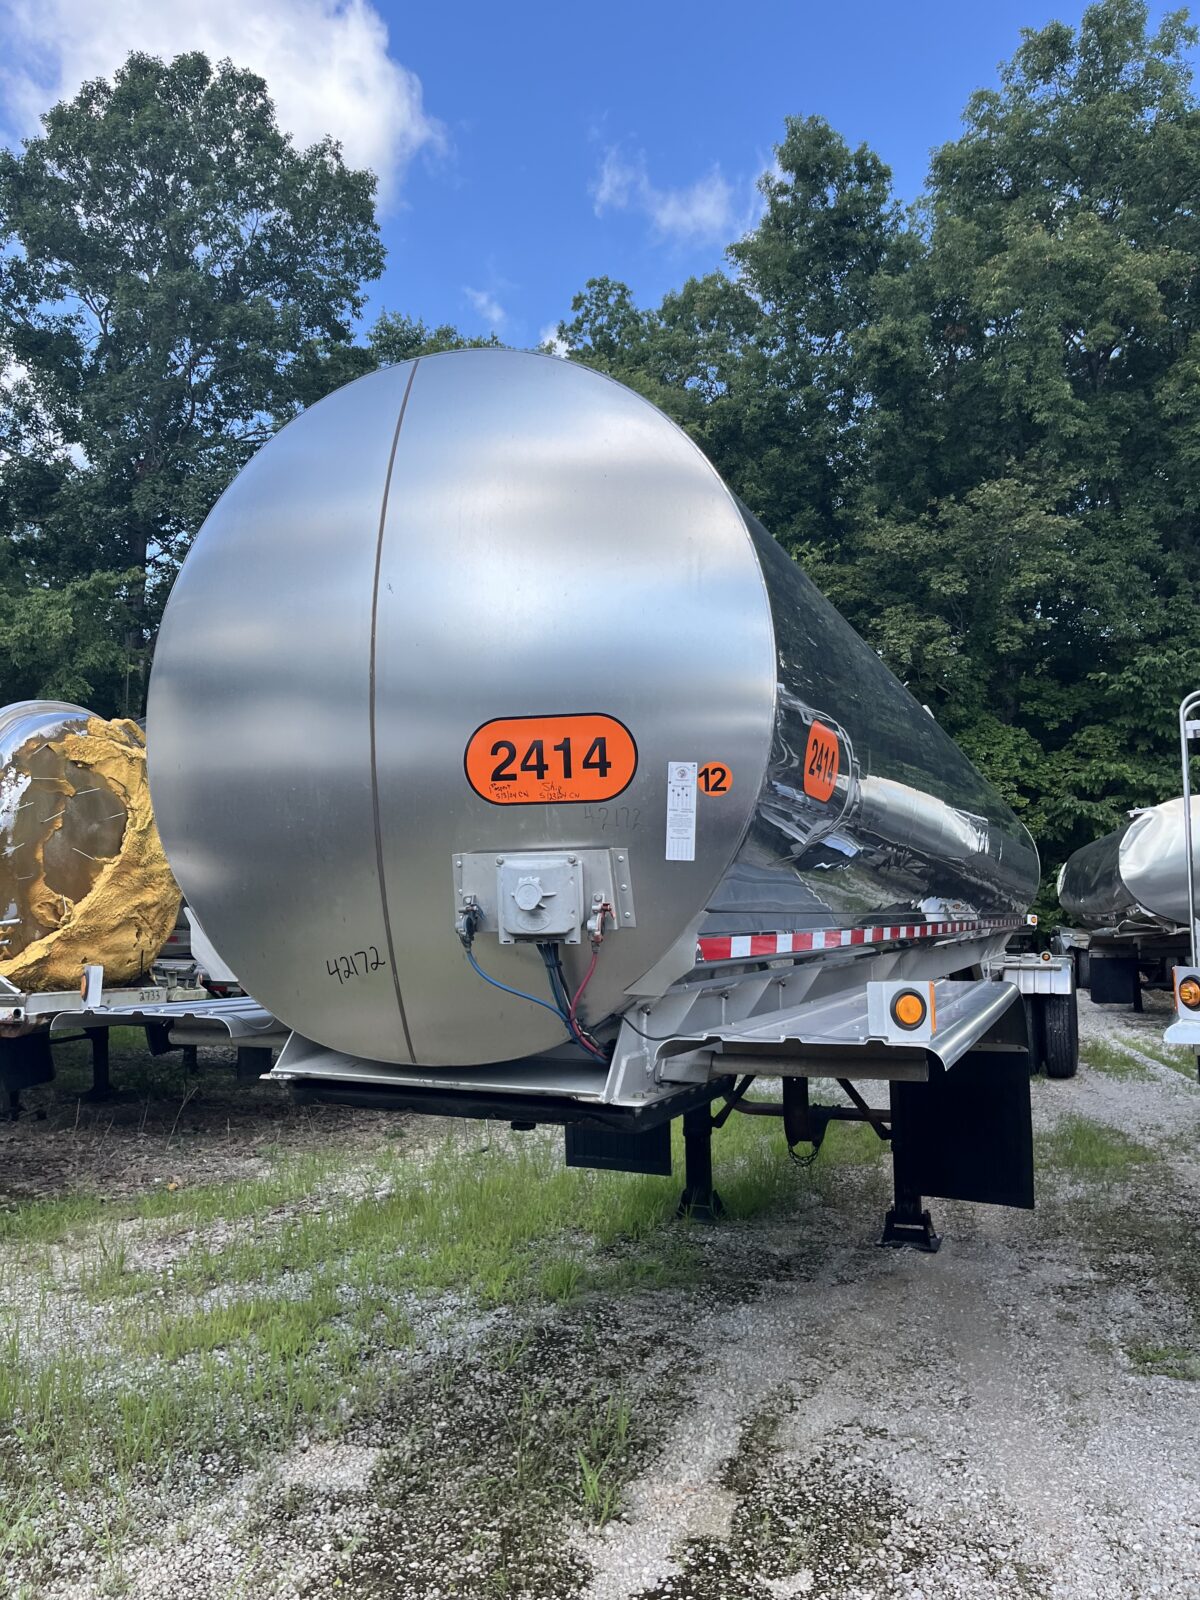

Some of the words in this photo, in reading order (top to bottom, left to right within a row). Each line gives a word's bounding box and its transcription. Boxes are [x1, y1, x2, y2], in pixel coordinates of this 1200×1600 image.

[490, 737, 611, 782] 2414
[809, 738, 835, 786] 2414
[698, 767, 727, 792] 12
[326, 946, 386, 984] 42172
[139, 991, 161, 1002] 2733
